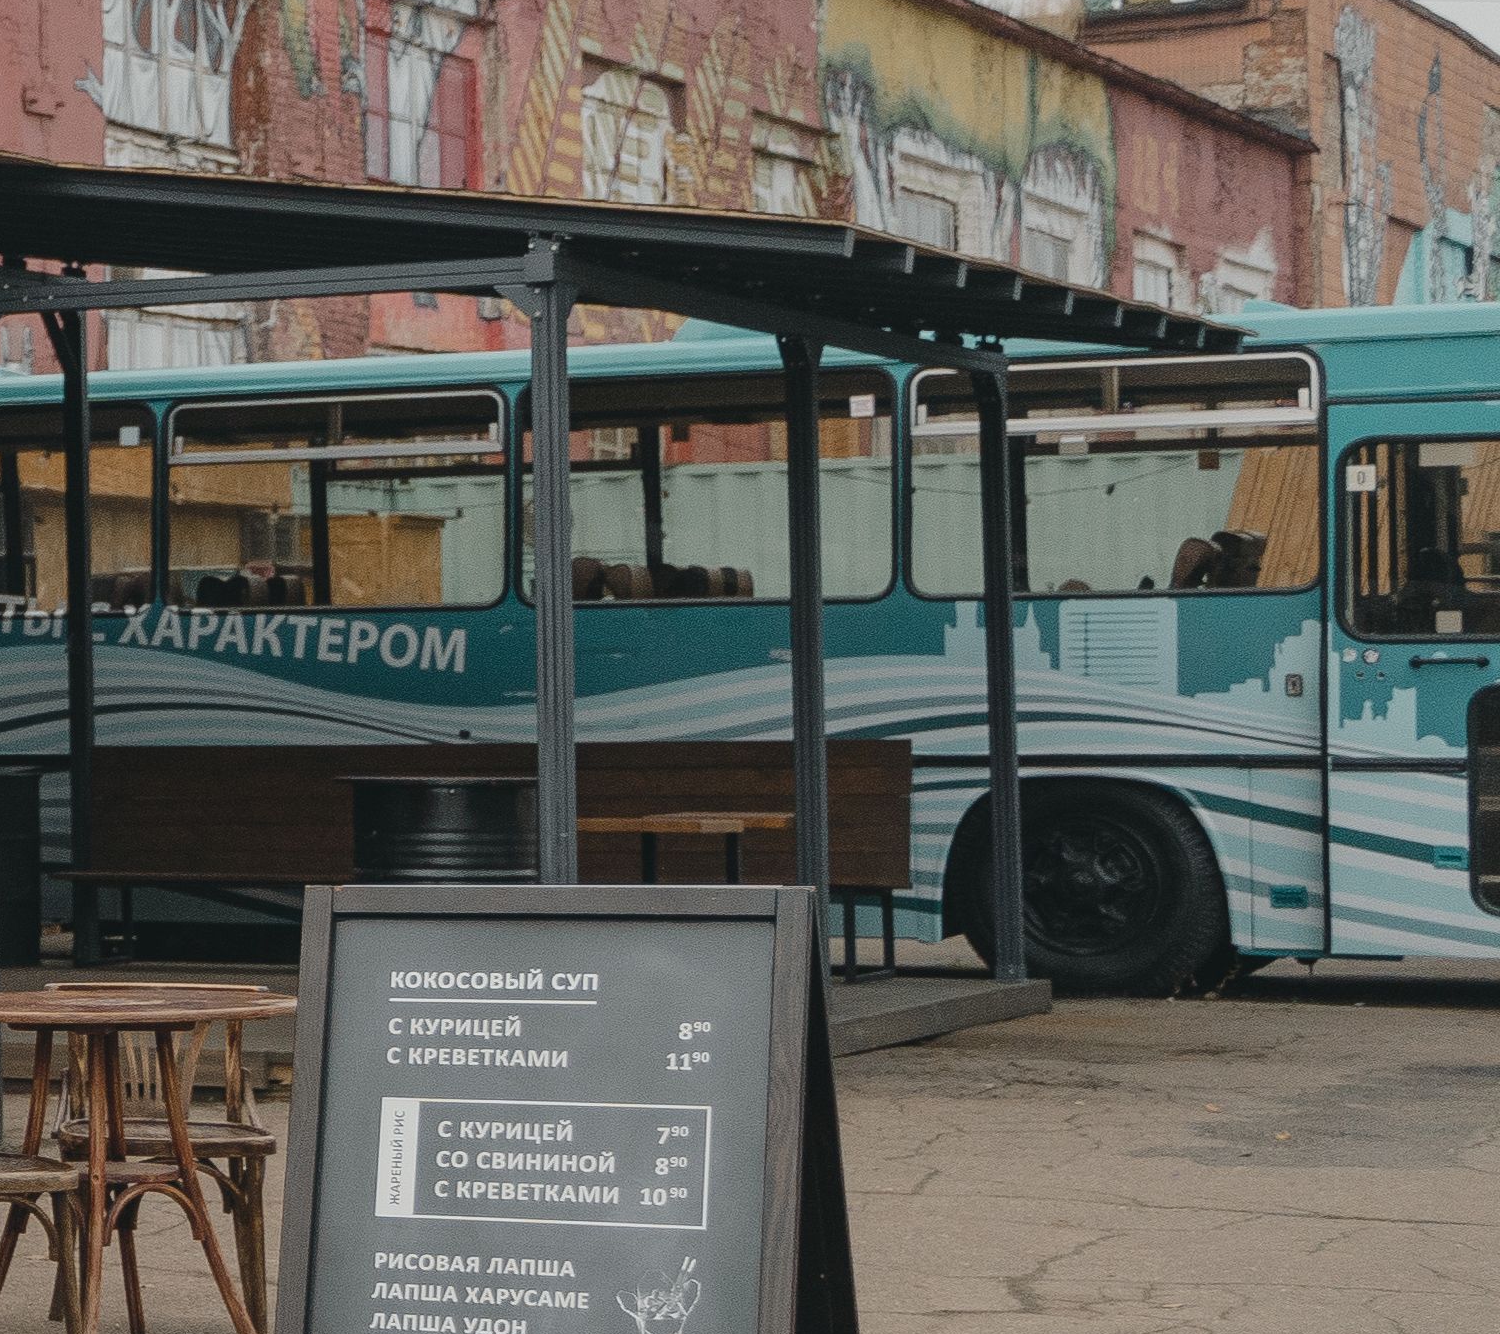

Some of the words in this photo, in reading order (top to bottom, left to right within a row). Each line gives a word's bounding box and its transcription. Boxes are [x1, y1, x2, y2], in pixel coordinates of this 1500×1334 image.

[118, 603, 467, 673] ХАРАКТЕРОМ
[390, 968, 543, 990] КОКОСОВЫЙ
[551, 972, 599, 991] СУП
[388, 1017, 403, 1036] С
[410, 1015, 522, 1039] КУРИЦЕЙ
[386, 1047, 400, 1064] С
[408, 1047, 569, 1068] КРЕВЕТКАМИ
[394, 1110, 406, 1139] РИС
[437, 1120, 451, 1138] С
[459, 1120, 573, 1144] КУРИЦЕЙ
[389, 1140, 405, 1206] ЖАРЕНЫЙ
[436, 1150, 468, 1169] СО
[476, 1151, 616, 1173] СВИНИНОЙ
[434, 1180, 448, 1198] С
[456, 1181, 620, 1205] КРЕВЕТКАМИ
[374, 1252, 480, 1274] РИСОВАЯ
[486, 1256, 576, 1278] ЛАПША
[371, 1282, 457, 1303] ЛАПША
[465, 1286, 590, 1310] ХАРУСАМЕ
[369, 1312, 456, 1334] ЛАПША
